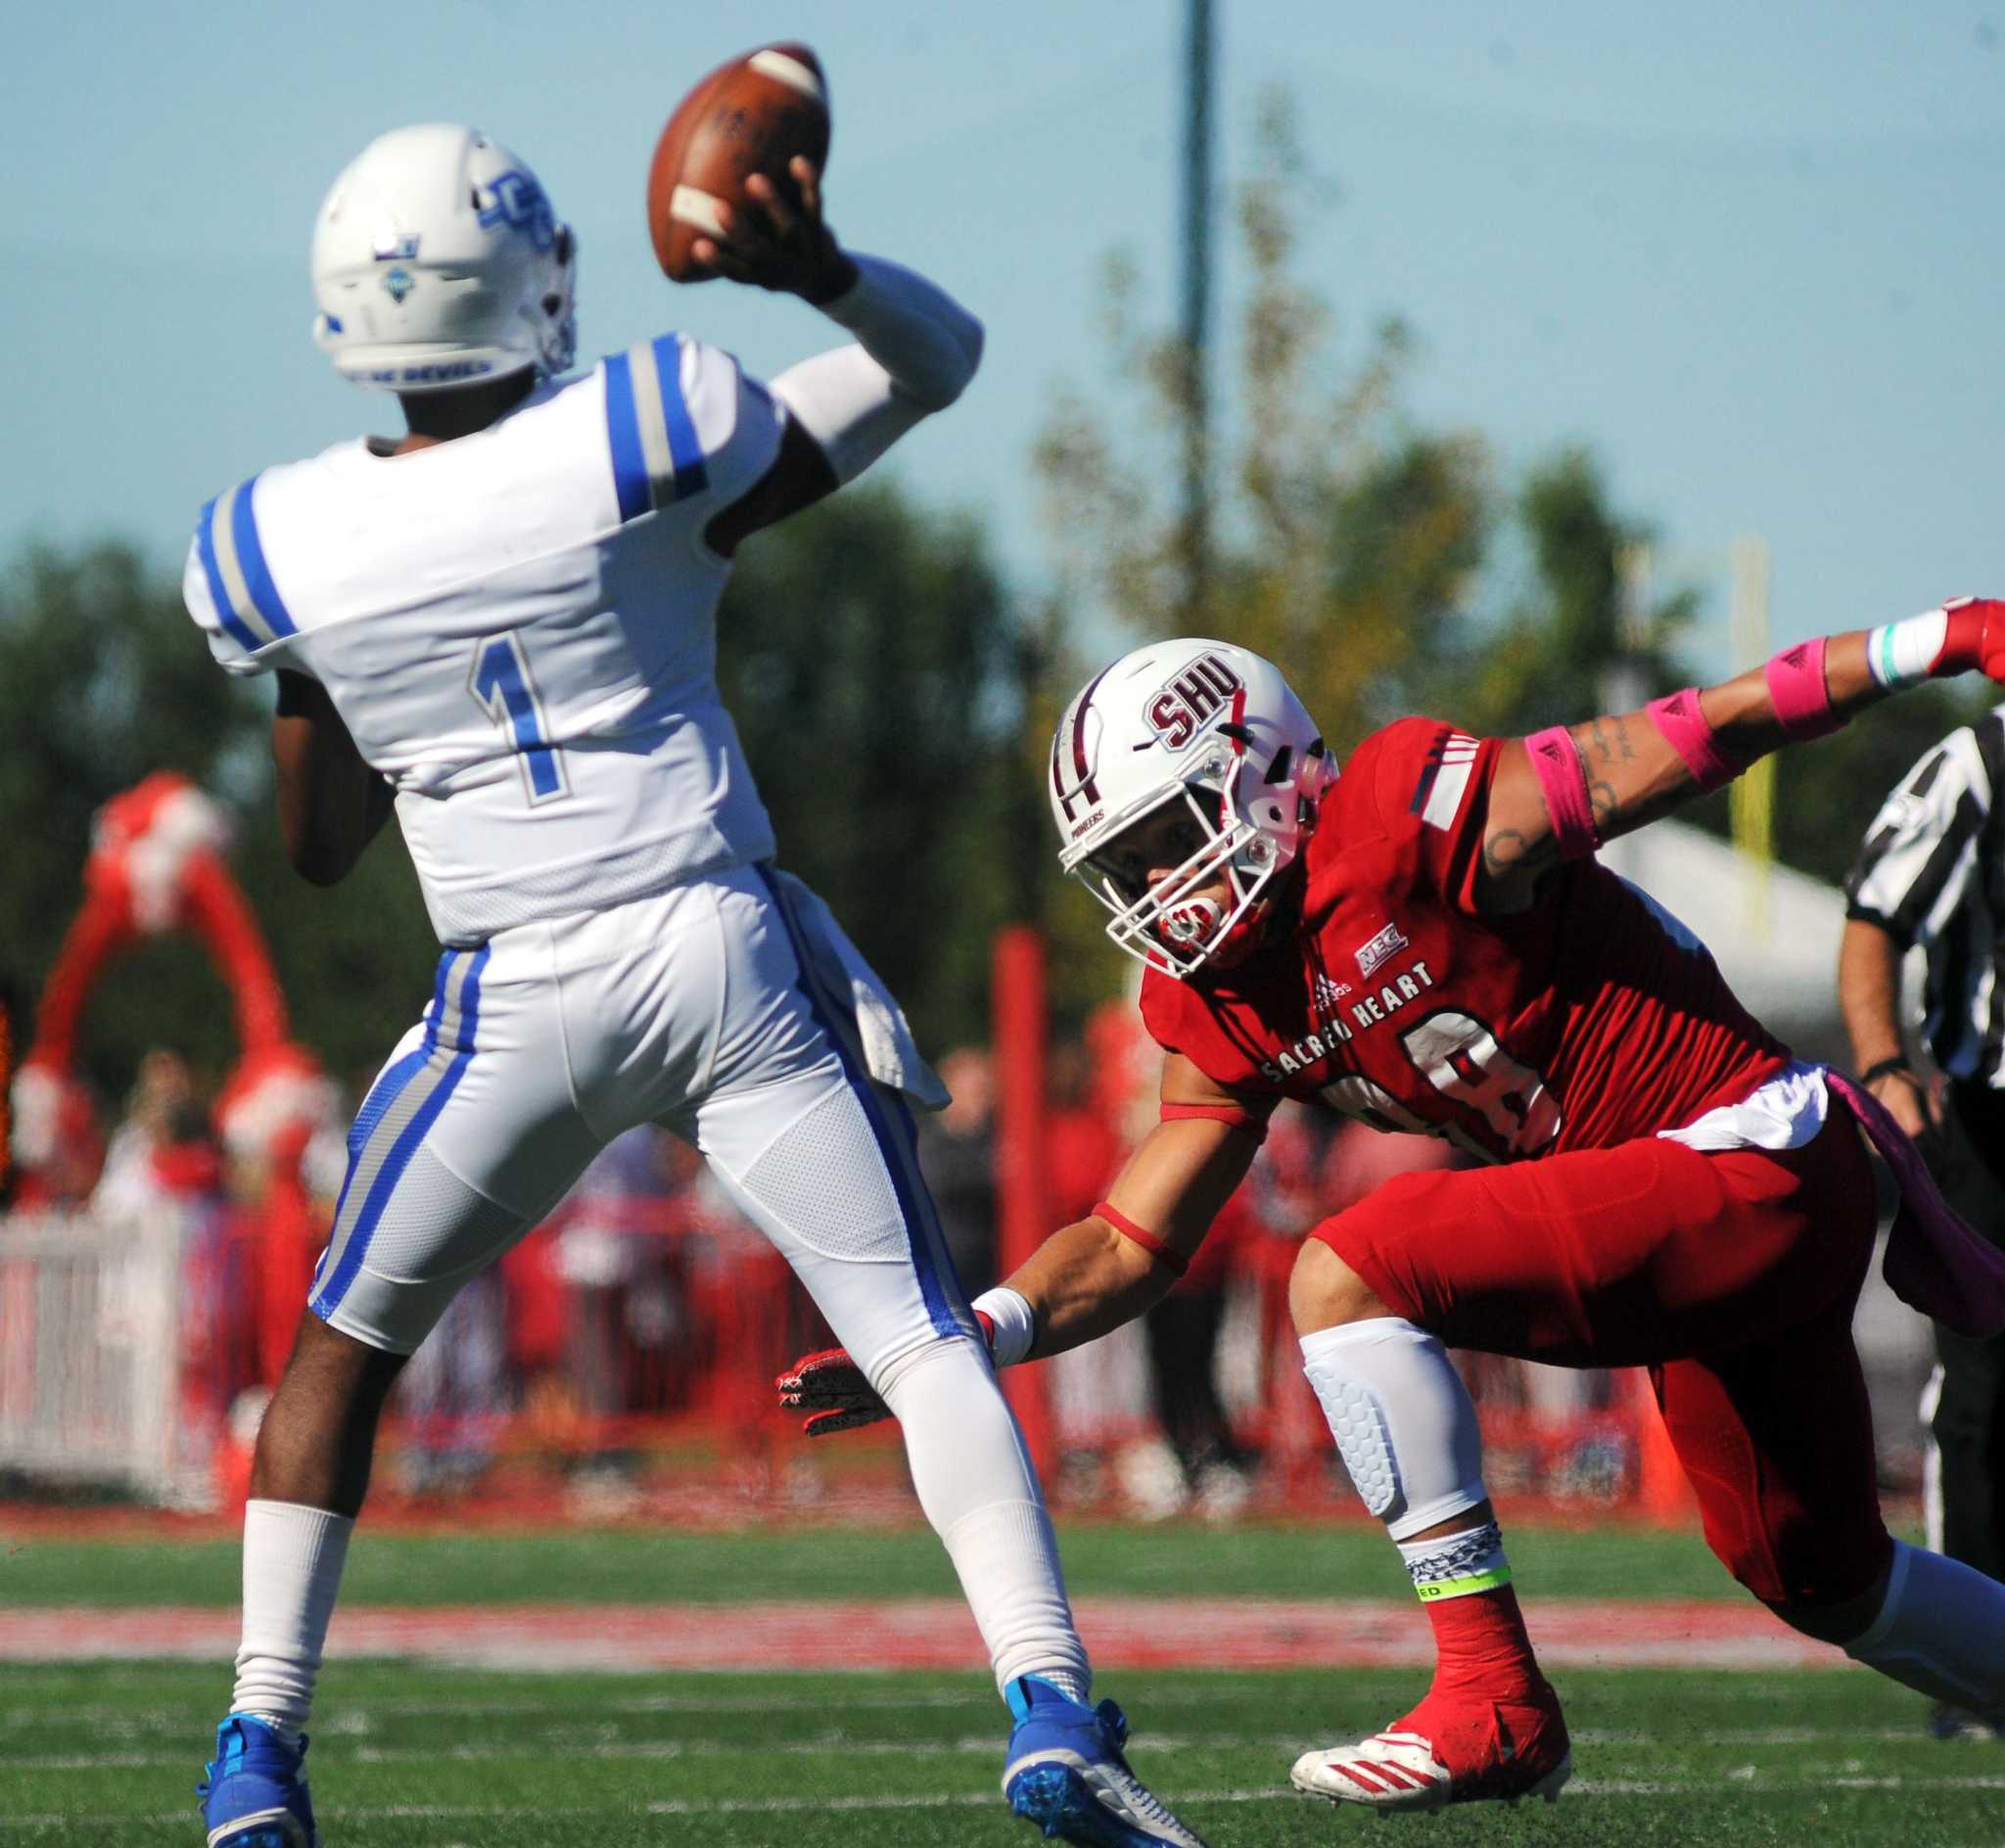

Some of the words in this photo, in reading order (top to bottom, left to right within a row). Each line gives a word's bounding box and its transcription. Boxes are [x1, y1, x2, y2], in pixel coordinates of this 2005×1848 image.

[466, 630, 574, 808] 1
[1142, 651, 1244, 753] SHU
[1360, 927, 1397, 971] NEC
[1351, 961, 1434, 1028] HEART
